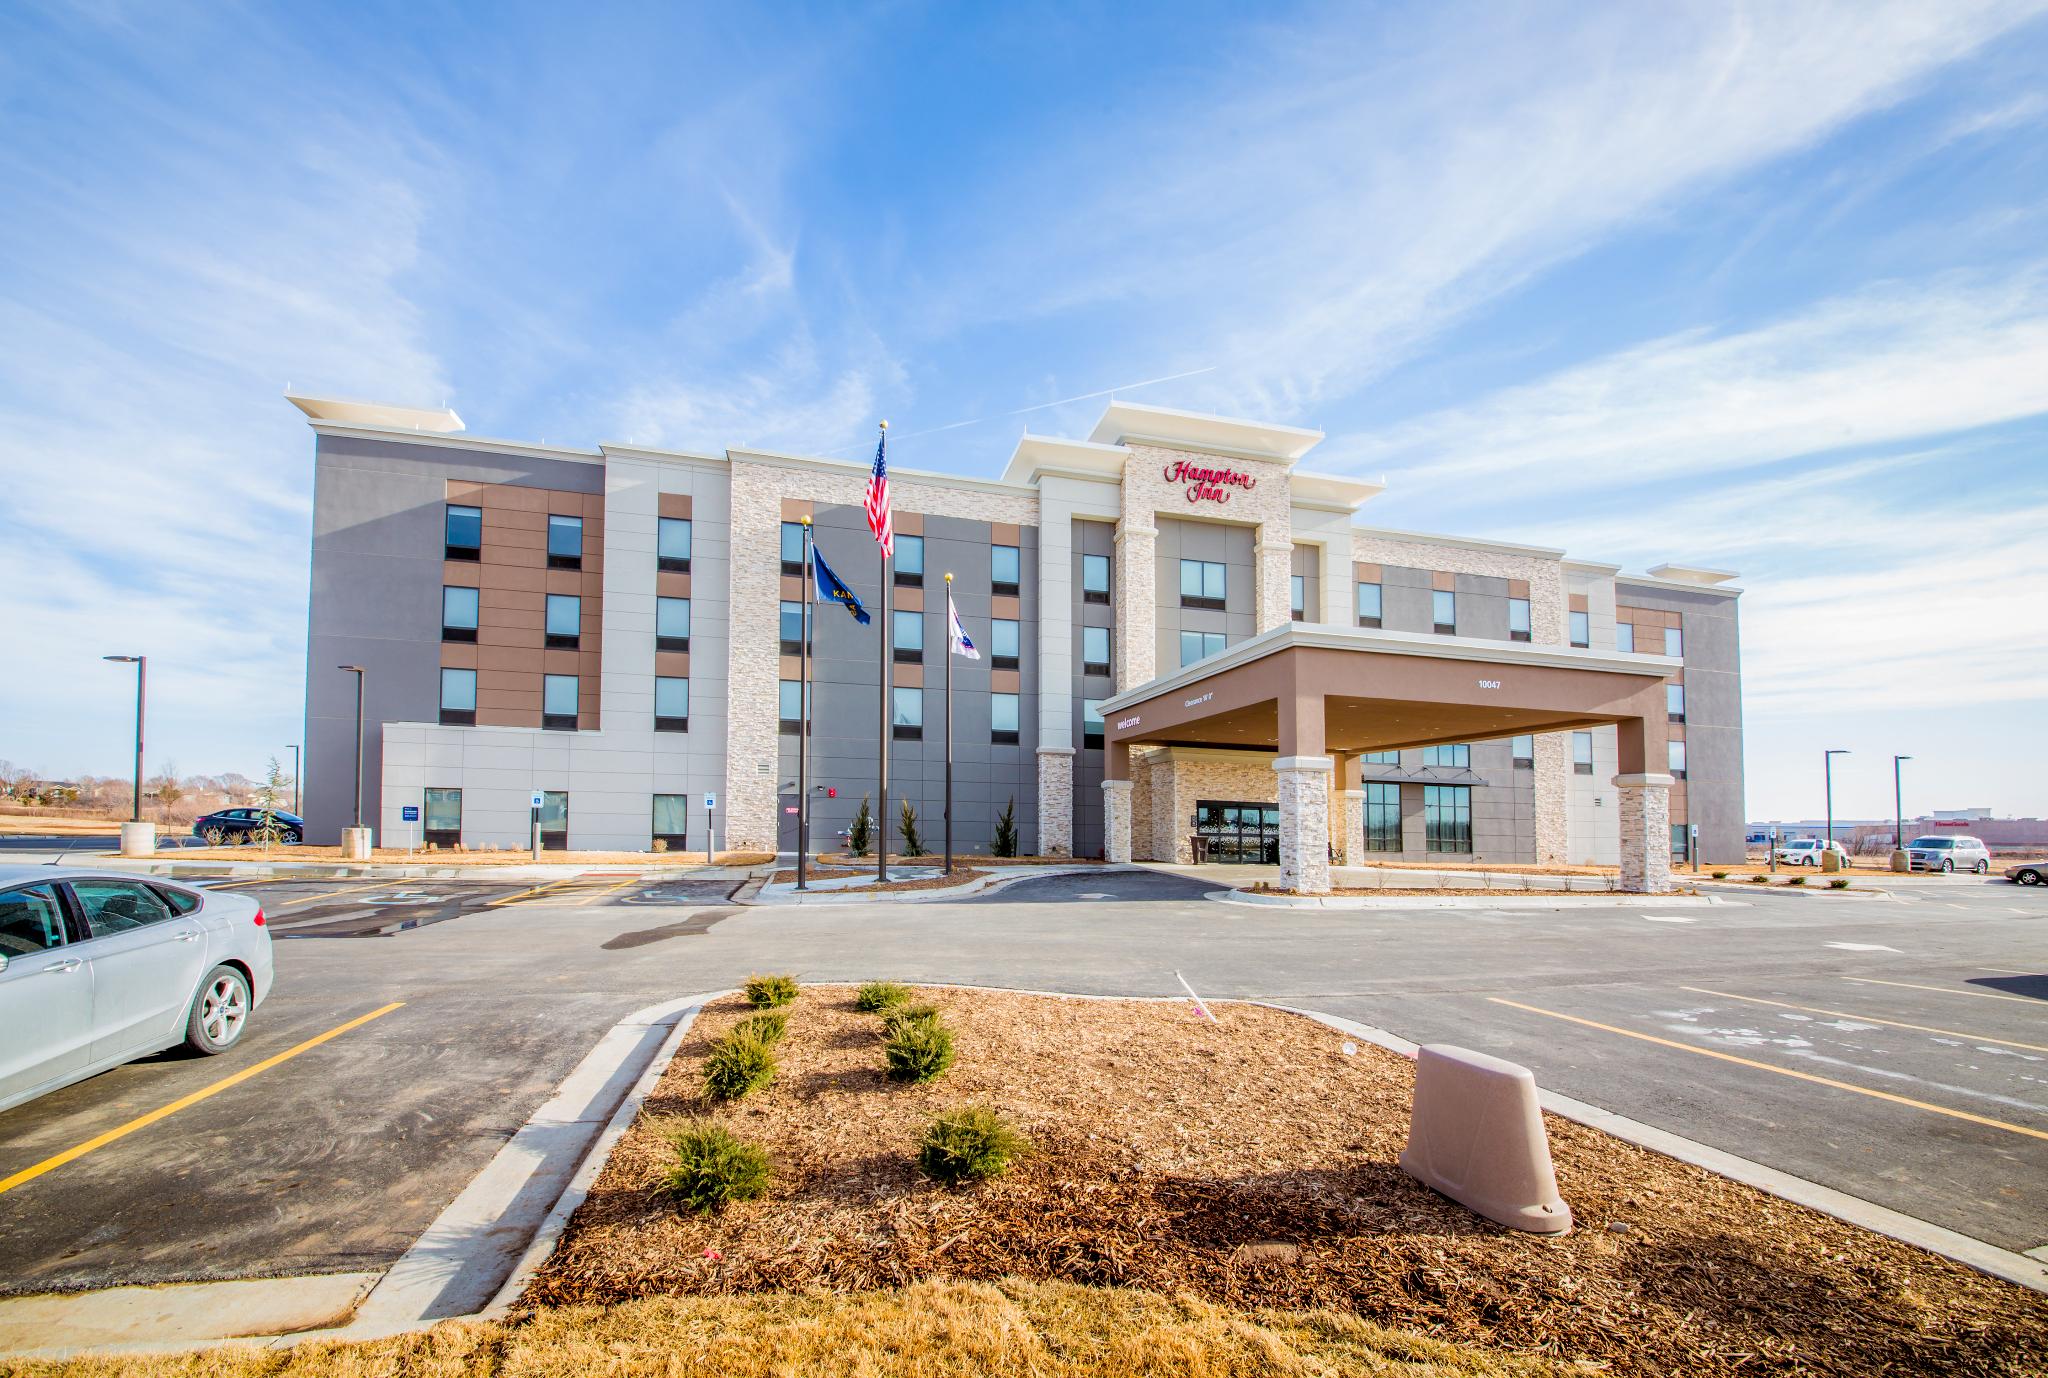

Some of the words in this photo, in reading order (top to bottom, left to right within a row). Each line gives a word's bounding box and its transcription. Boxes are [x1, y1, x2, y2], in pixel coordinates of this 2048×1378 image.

[1164, 461, 1256, 490] Hampton
[1187, 482, 1230, 503] Inn
[1478, 680, 1501, 689] 10047
[1117, 715, 1141, 730] welcome
